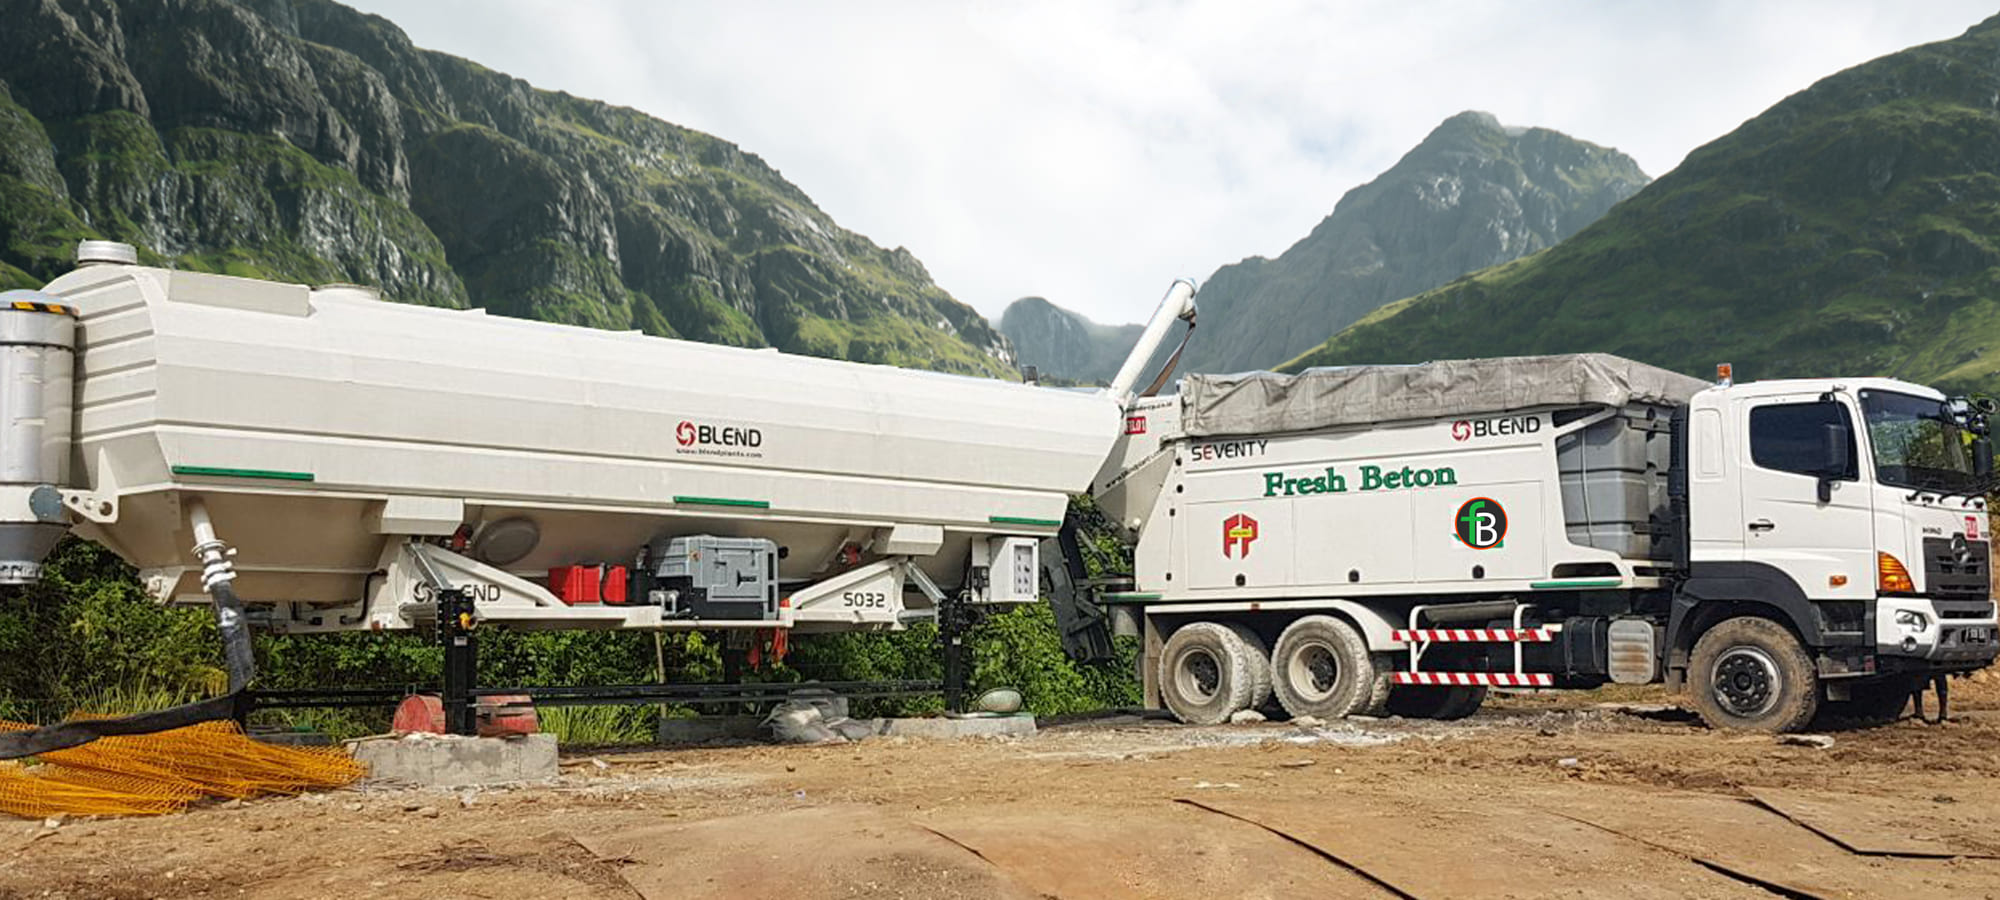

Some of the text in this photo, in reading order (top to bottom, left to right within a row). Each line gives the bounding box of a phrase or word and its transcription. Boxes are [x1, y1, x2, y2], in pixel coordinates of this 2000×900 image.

[698, 425, 762, 447] BLEND
[1474, 416, 1541, 437] BLEND
[1191, 439, 1269, 461] SEVENTY
[1263, 465, 1458, 497] Fresh Beton
[459, 584, 501, 602] END
